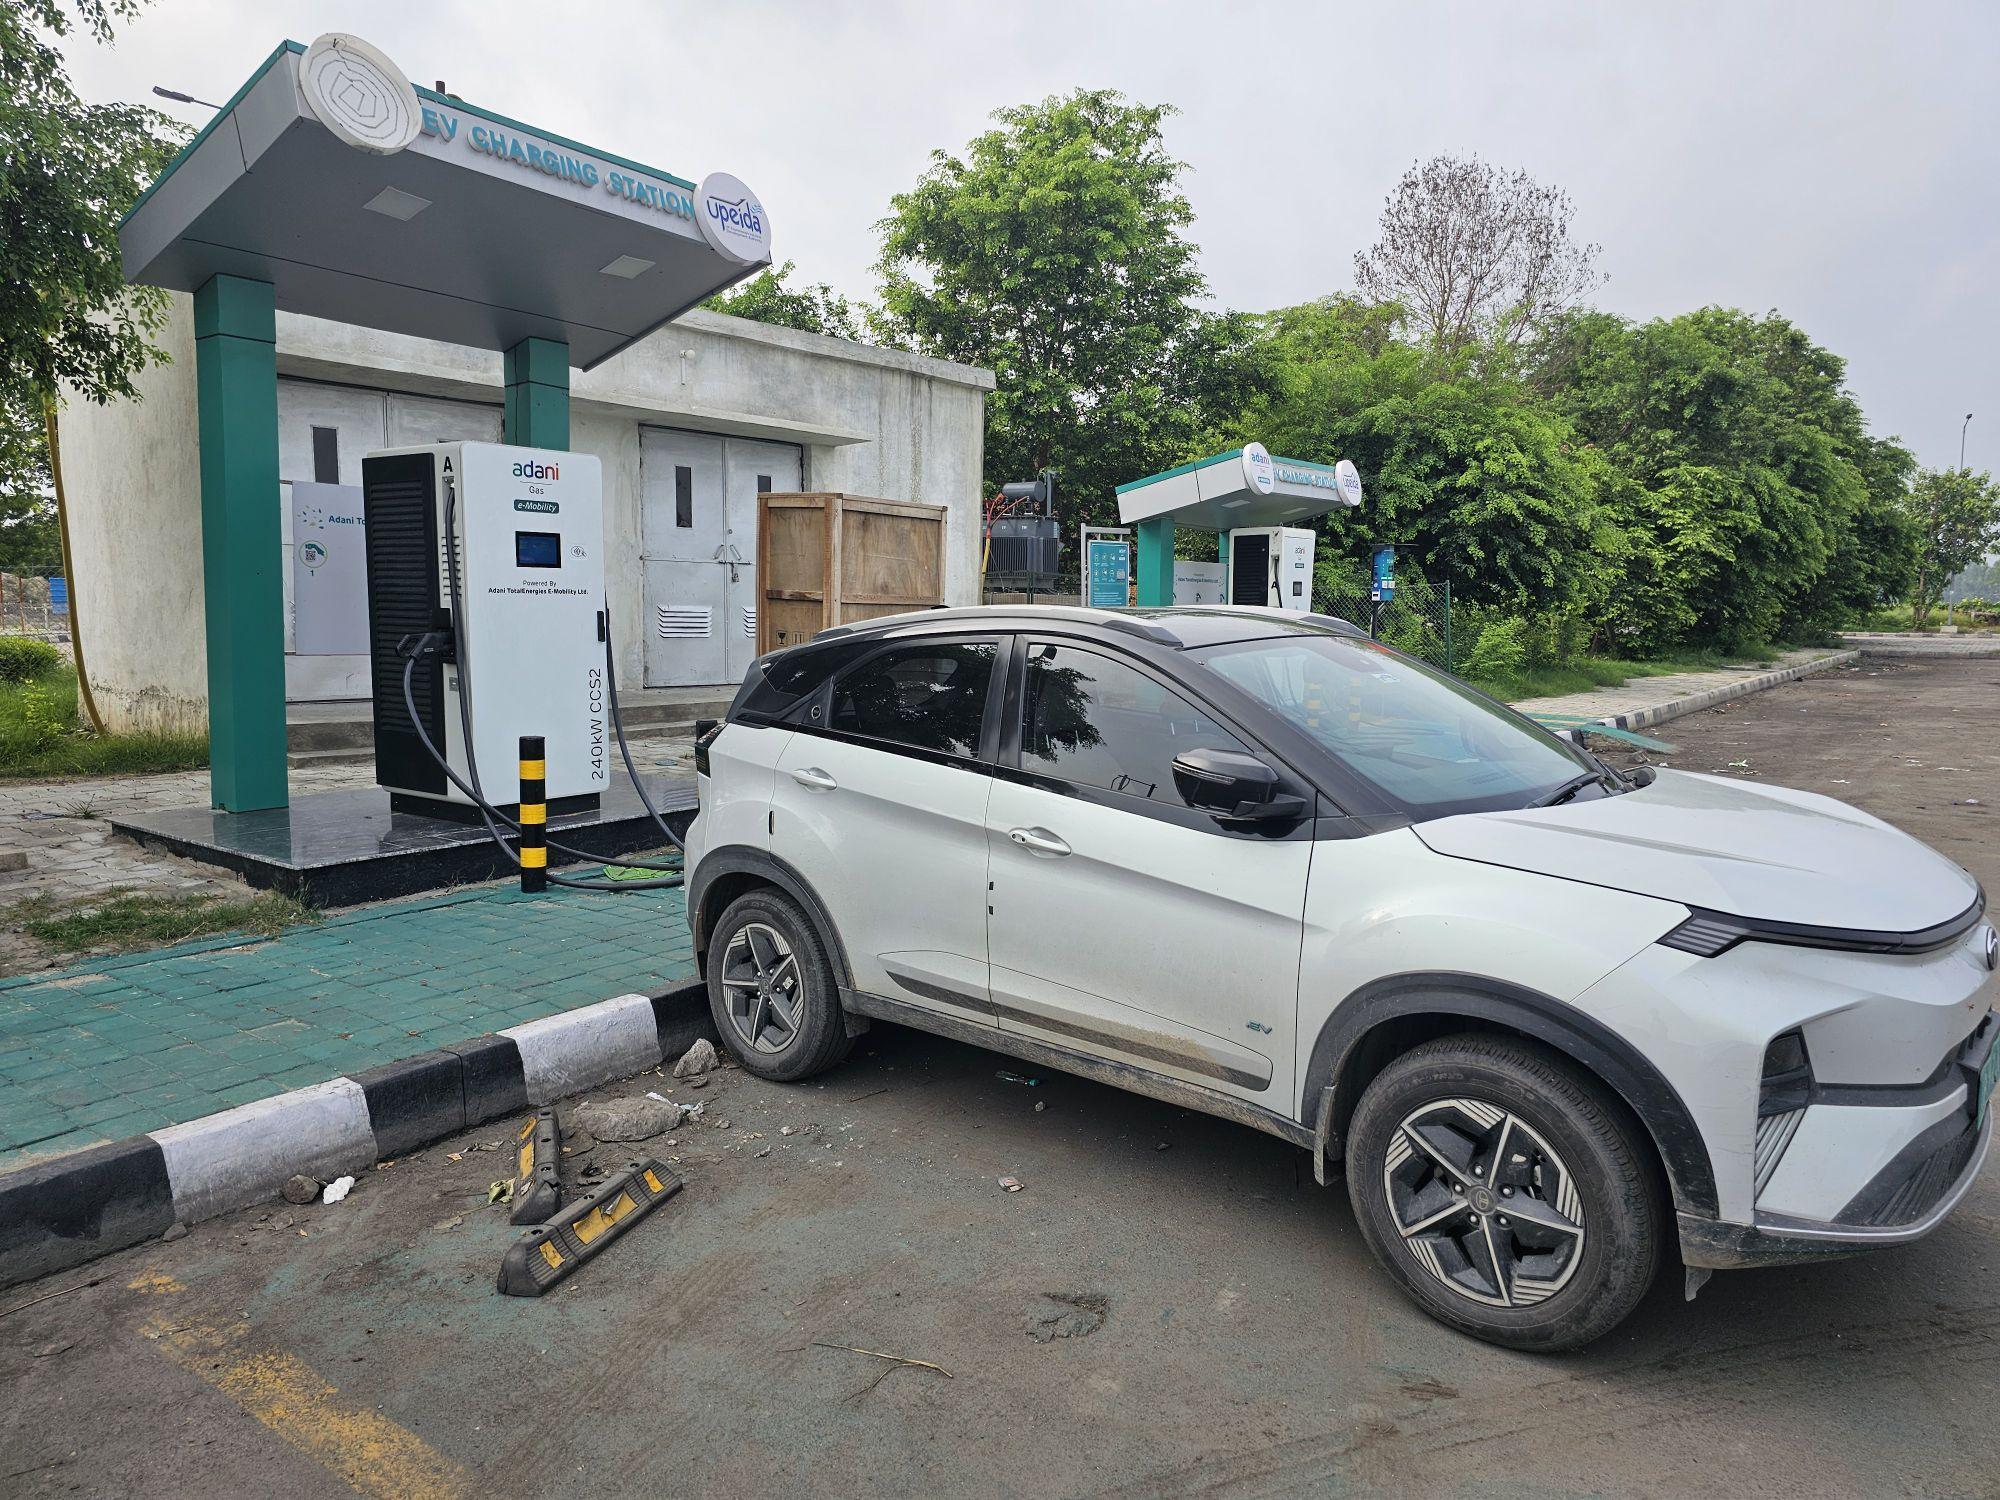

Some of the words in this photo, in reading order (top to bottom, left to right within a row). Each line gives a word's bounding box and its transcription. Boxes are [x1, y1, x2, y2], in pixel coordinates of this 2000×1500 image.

[421, 108, 458, 142] EV
[468, 126, 599, 188] CHARGING
[604, 171, 696, 221] STATION
[706, 199, 762, 234] upeida
[443, 456, 453, 473] A
[512, 460, 559, 481] adani
[528, 485, 545, 495] Gas
[517, 501, 557, 513] e-Mobility
[328, 515, 354, 525] Adani
[507, 588, 547, 596] TotalEnergies
[549, 580, 557, 588] By
[588, 668, 602, 713] CCS2
[591, 719, 604, 781] 240kW
